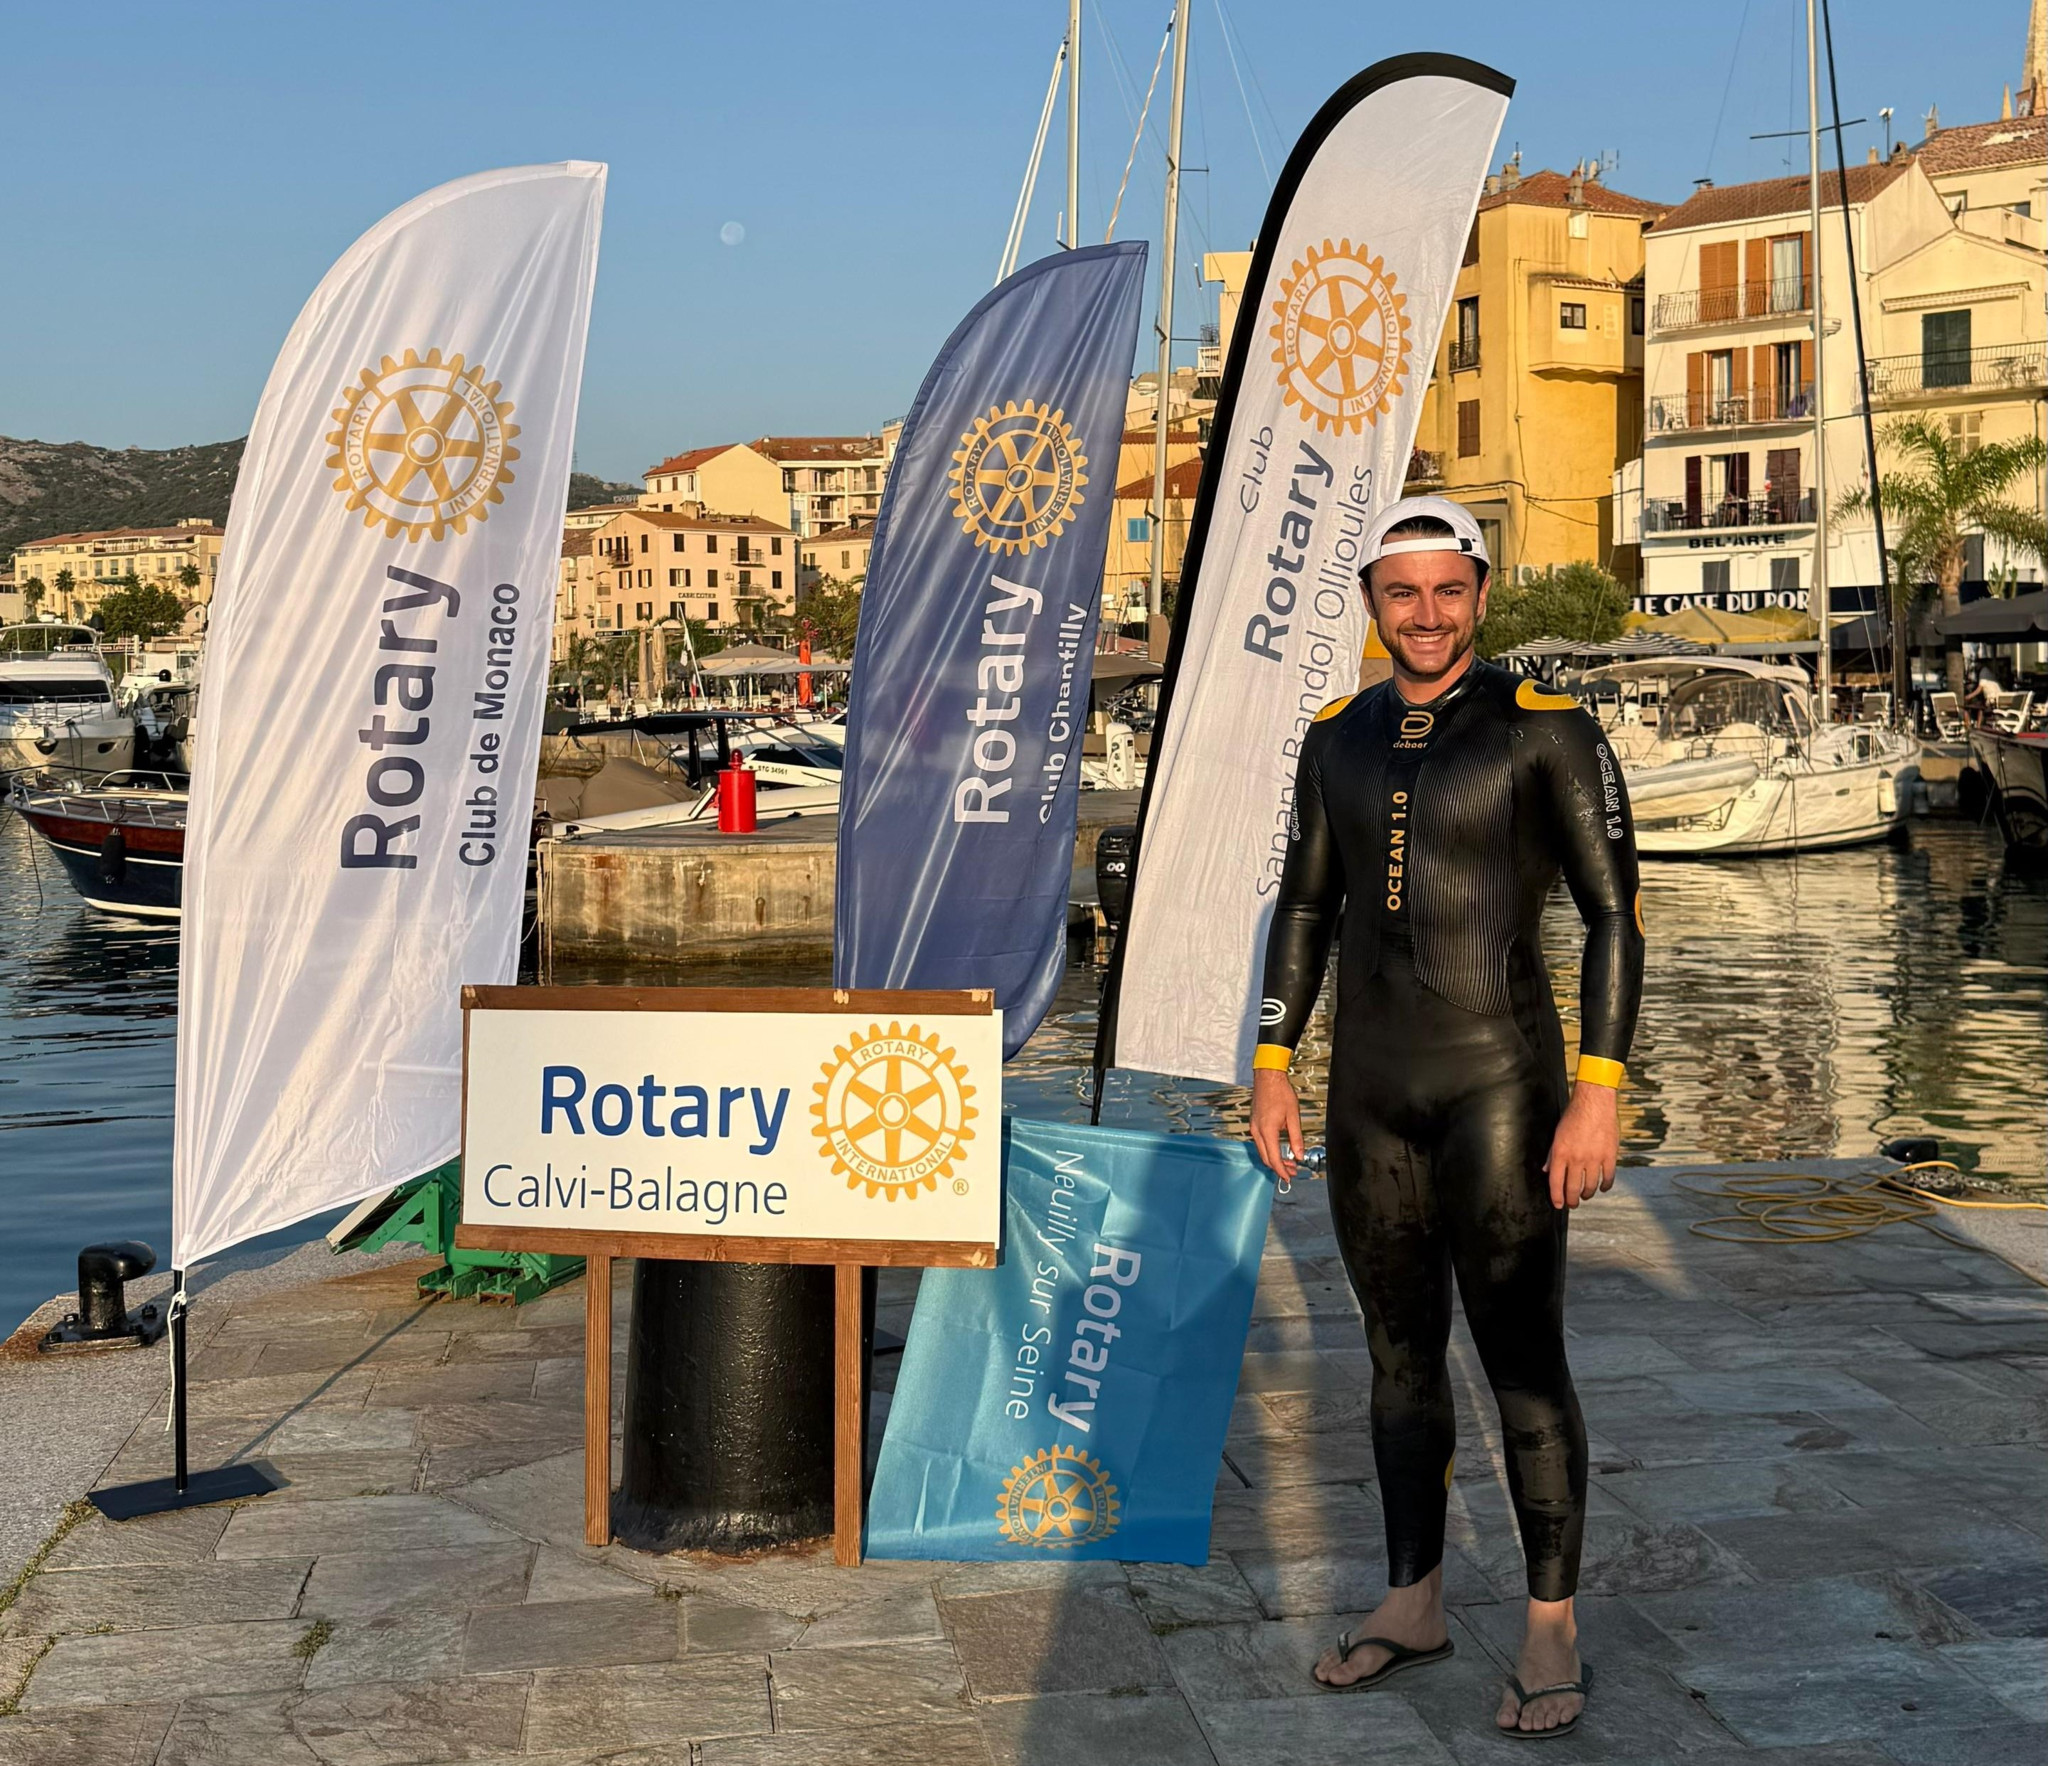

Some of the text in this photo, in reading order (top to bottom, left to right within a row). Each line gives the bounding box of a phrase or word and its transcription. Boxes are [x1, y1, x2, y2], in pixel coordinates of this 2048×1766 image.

[1285, 277, 1311, 357] ROTARY
[1350, 284, 1399, 414] INTERNATIONAL
[345, 400, 372, 481] ROTARY
[447, 380, 499, 516] INTERNATIONAL
[962, 442, 985, 508] ROTARY
[1031, 422, 1075, 534] INTERNATIONAL
[1240, 426, 1274, 514] Club
[1243, 439, 1335, 664] Rotary
[1314, 465, 1373, 620] Ollioules
[1726, 592, 1757, 612] DU
[1764, 590, 1810, 610] POR
[339, 565, 461, 870] Rotary
[459, 583, 521, 867] Club de Monaco
[953, 574, 1044, 824] Rotary
[1048, 602, 1088, 742] Chantilly
[1597, 744, 1623, 840] OCEAN 1.0
[1387, 791, 1408, 911] OCEAN 1.0
[859, 1041, 931, 1063] ROTARY
[540, 1065, 791, 1156] Rotary
[835, 1136, 953, 1184] INTERNATIONAL
[484, 1163, 788, 1225] Calvi-Balagne
[1005, 1149, 1085, 1420] Neuilly sur Seine
[1048, 1242, 1141, 1433] Rotary
